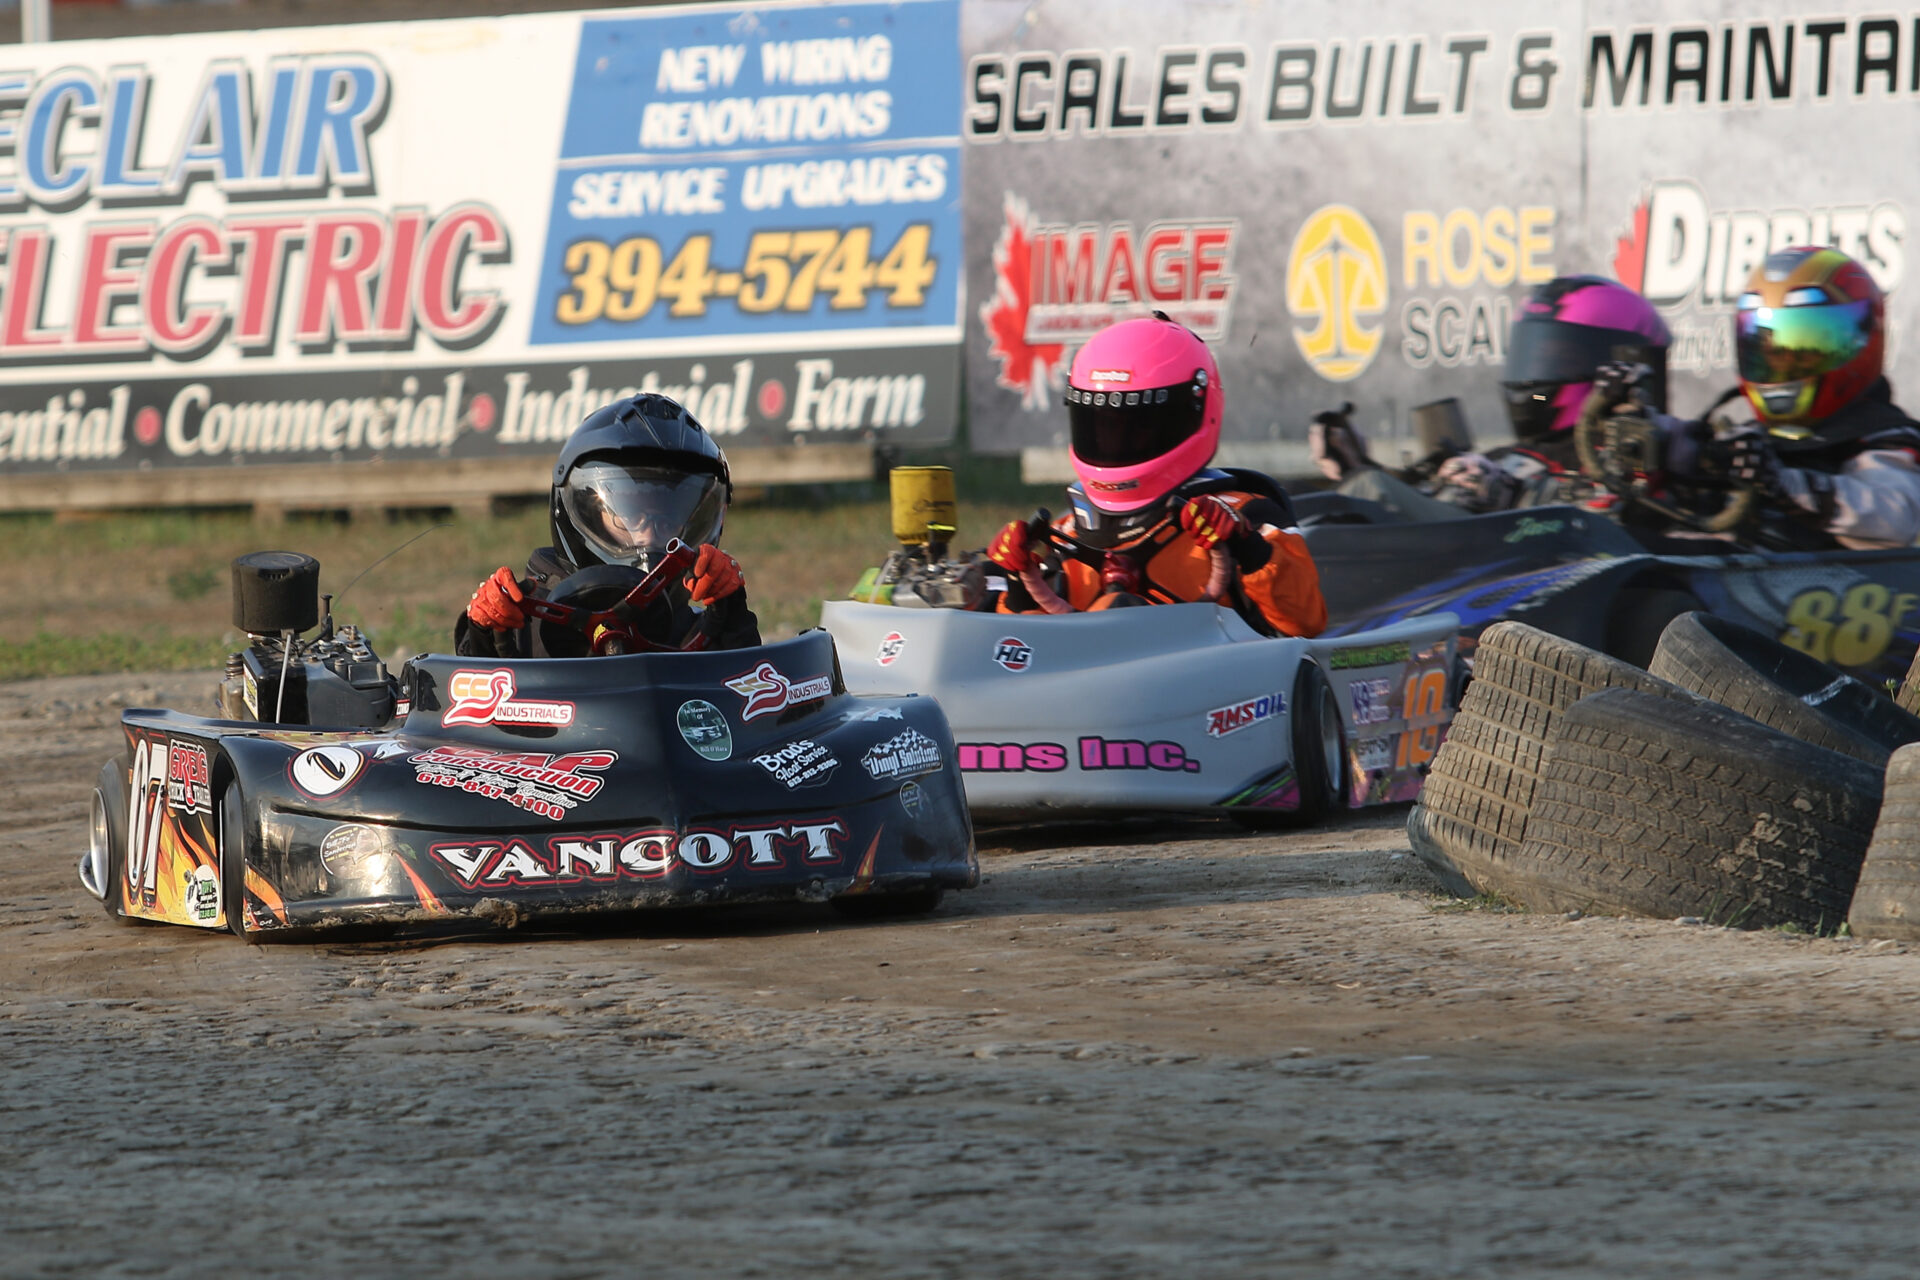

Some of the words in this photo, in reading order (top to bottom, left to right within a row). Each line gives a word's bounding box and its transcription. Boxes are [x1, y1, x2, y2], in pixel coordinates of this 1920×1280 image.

[656, 43, 747, 93] NEW
[761, 34, 892, 85] WIRING
[967, 46, 1248, 142] SCALES
[1266, 37, 1489, 124] BUILT
[1509, 34, 1559, 111] &
[639, 91, 892, 148] RENOVATIONS
[568, 168, 727, 219] SERVICE
[741, 154, 946, 211] UPGRADES
[555, 224, 937, 325] 394-5744
[1031, 218, 1240, 303] IMAGE
[1403, 208, 1556, 287] ROSE
[0, 202, 511, 360] LECTRIC
[165, 367, 466, 456] Commercial
[787, 359, 926, 432] Farm
[996, 645, 1033, 663] HG
[497, 706, 569, 720] INDUSTRIALS
[788, 680, 830, 700] INDUSTRIALS
[1207, 692, 1287, 735] AMSOIL
[865, 751, 900, 775] Vinyl
[899, 745, 939, 767] Solution
[956, 743, 1068, 773] ms
[1078, 736, 1200, 773] Inc.
[416, 772, 565, 820] 613-847-4100
[437, 822, 844, 882] VANCOTT
